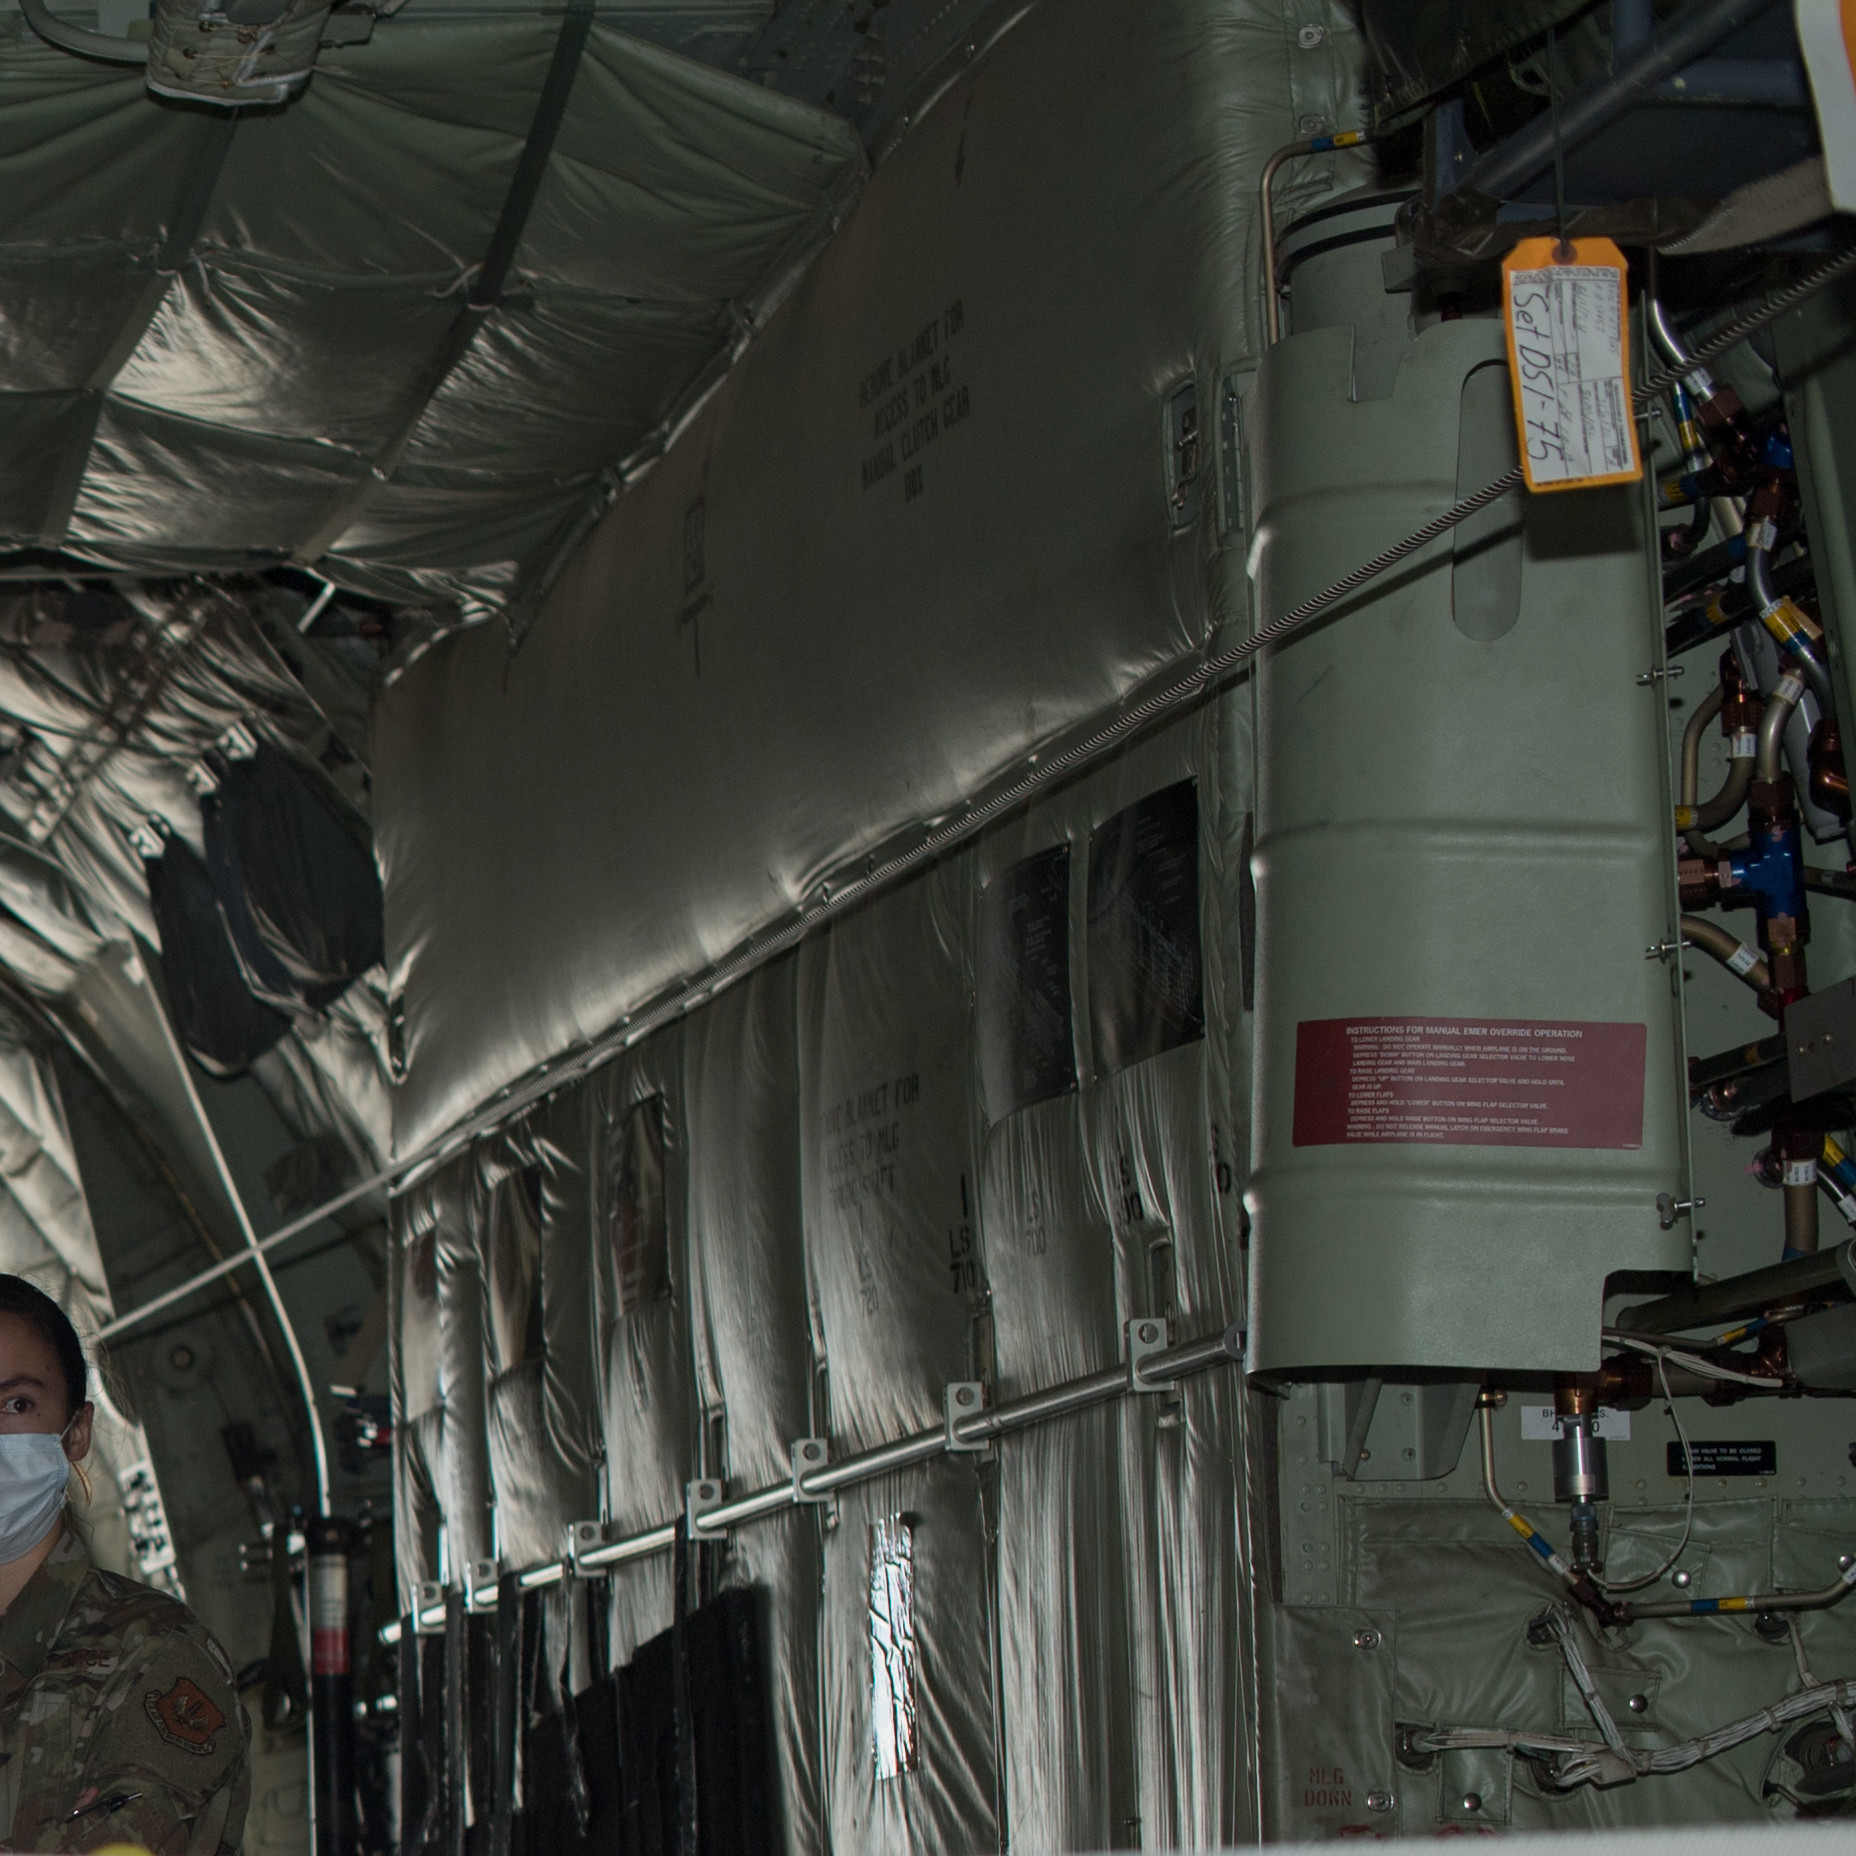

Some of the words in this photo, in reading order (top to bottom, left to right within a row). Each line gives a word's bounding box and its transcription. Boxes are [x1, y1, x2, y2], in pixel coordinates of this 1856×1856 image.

[944, 297, 964, 342] FOR
[1513, 292, 1550, 340] Set
[875, 386, 910, 440] ACCESS
[913, 373, 927, 406] TO
[1346, 1026, 1404, 1035] INSTRUCTIONS
[1406, 1026, 1424, 1034] FOR
[1426, 1026, 1461, 1035] MANUAL
[1463, 1027, 1487, 1036] EMER
[1490, 1028, 1531, 1037] OVERRIDE
[1534, 1029, 1583, 1038] OPERATION
[894, 1072, 920, 1107] FOR
[877, 1121, 900, 1154] MLG
[1304, 1789, 1352, 1807] DOWN
